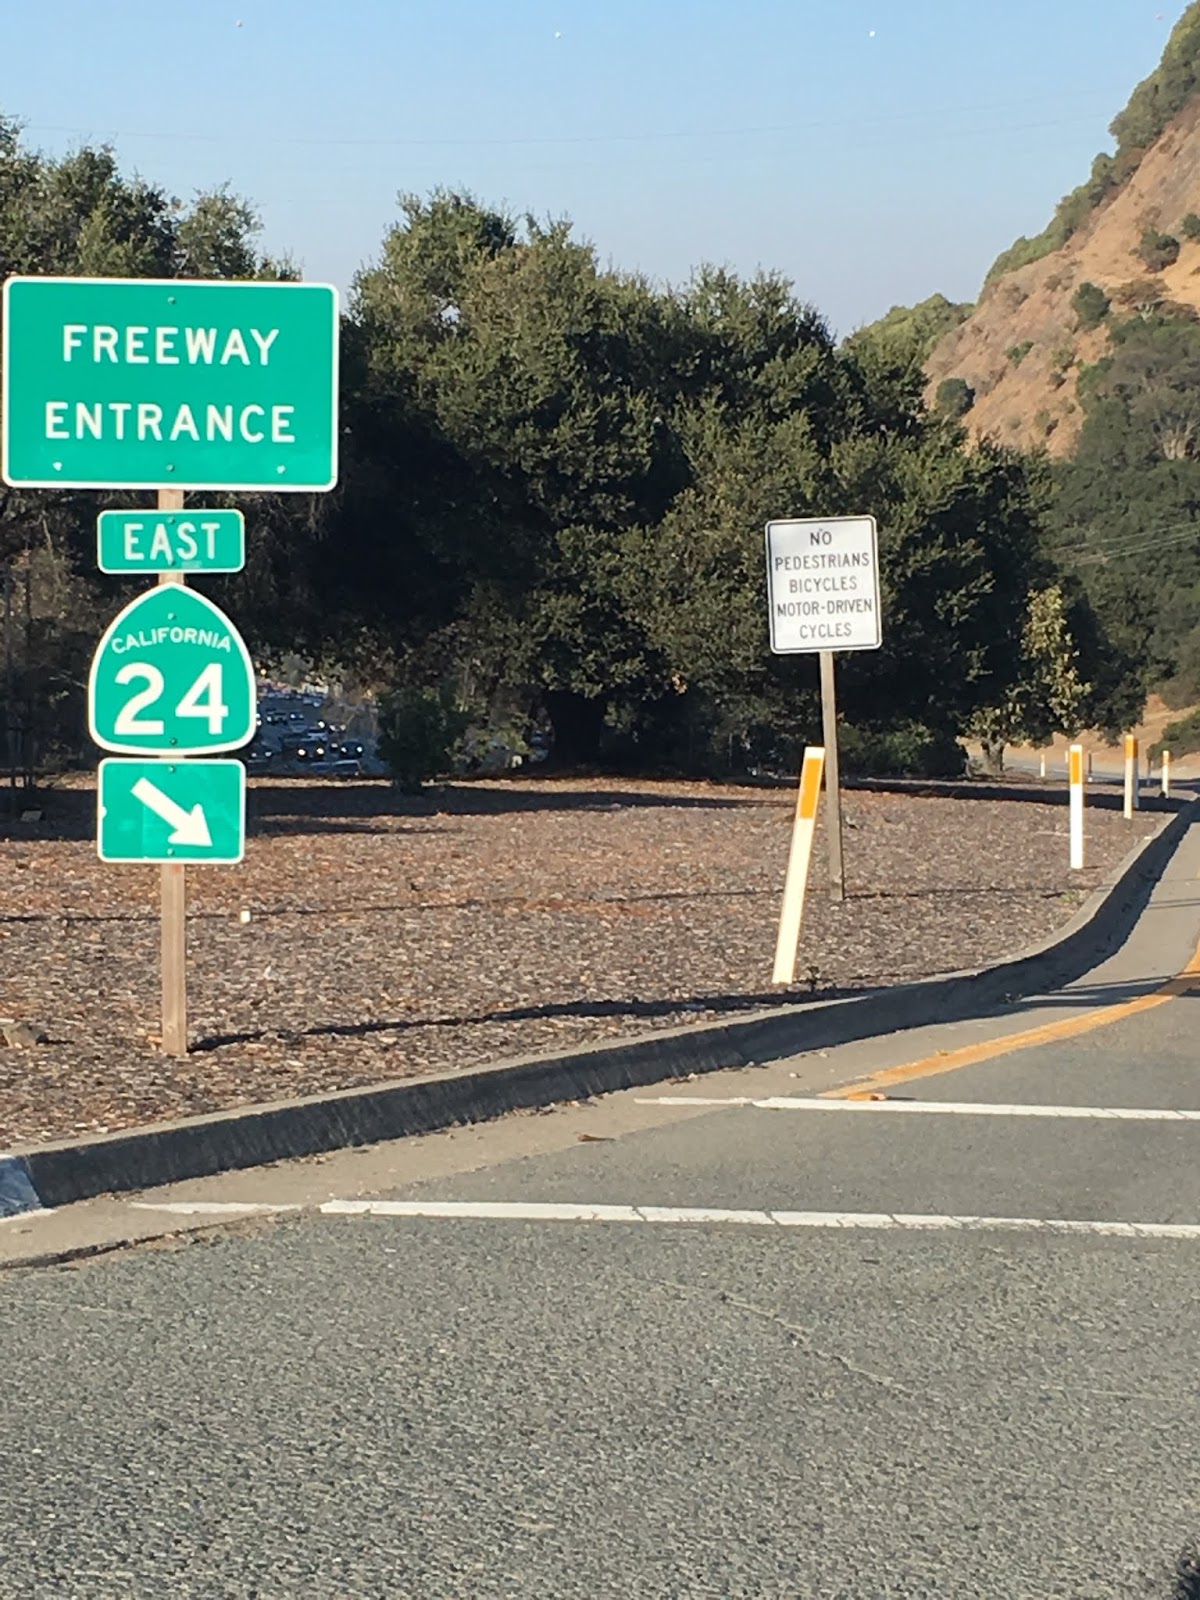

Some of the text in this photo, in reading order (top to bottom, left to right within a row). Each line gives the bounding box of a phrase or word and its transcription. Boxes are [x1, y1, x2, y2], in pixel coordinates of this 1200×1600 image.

[63, 324, 280, 366] FREEWAY
[45, 401, 296, 443] ENTRANCE
[123, 522, 221, 562] EAST
[809, 530, 833, 547] NO
[774, 552, 870, 571] PEDESTRIANS
[789, 575, 858, 594] BICYCLES
[777, 598, 873, 617] MOTOR-DRIVEN
[111, 626, 231, 654] CALIFORNIA
[799, 622, 853, 639] CYCLES
[113, 662, 229, 735] 24
